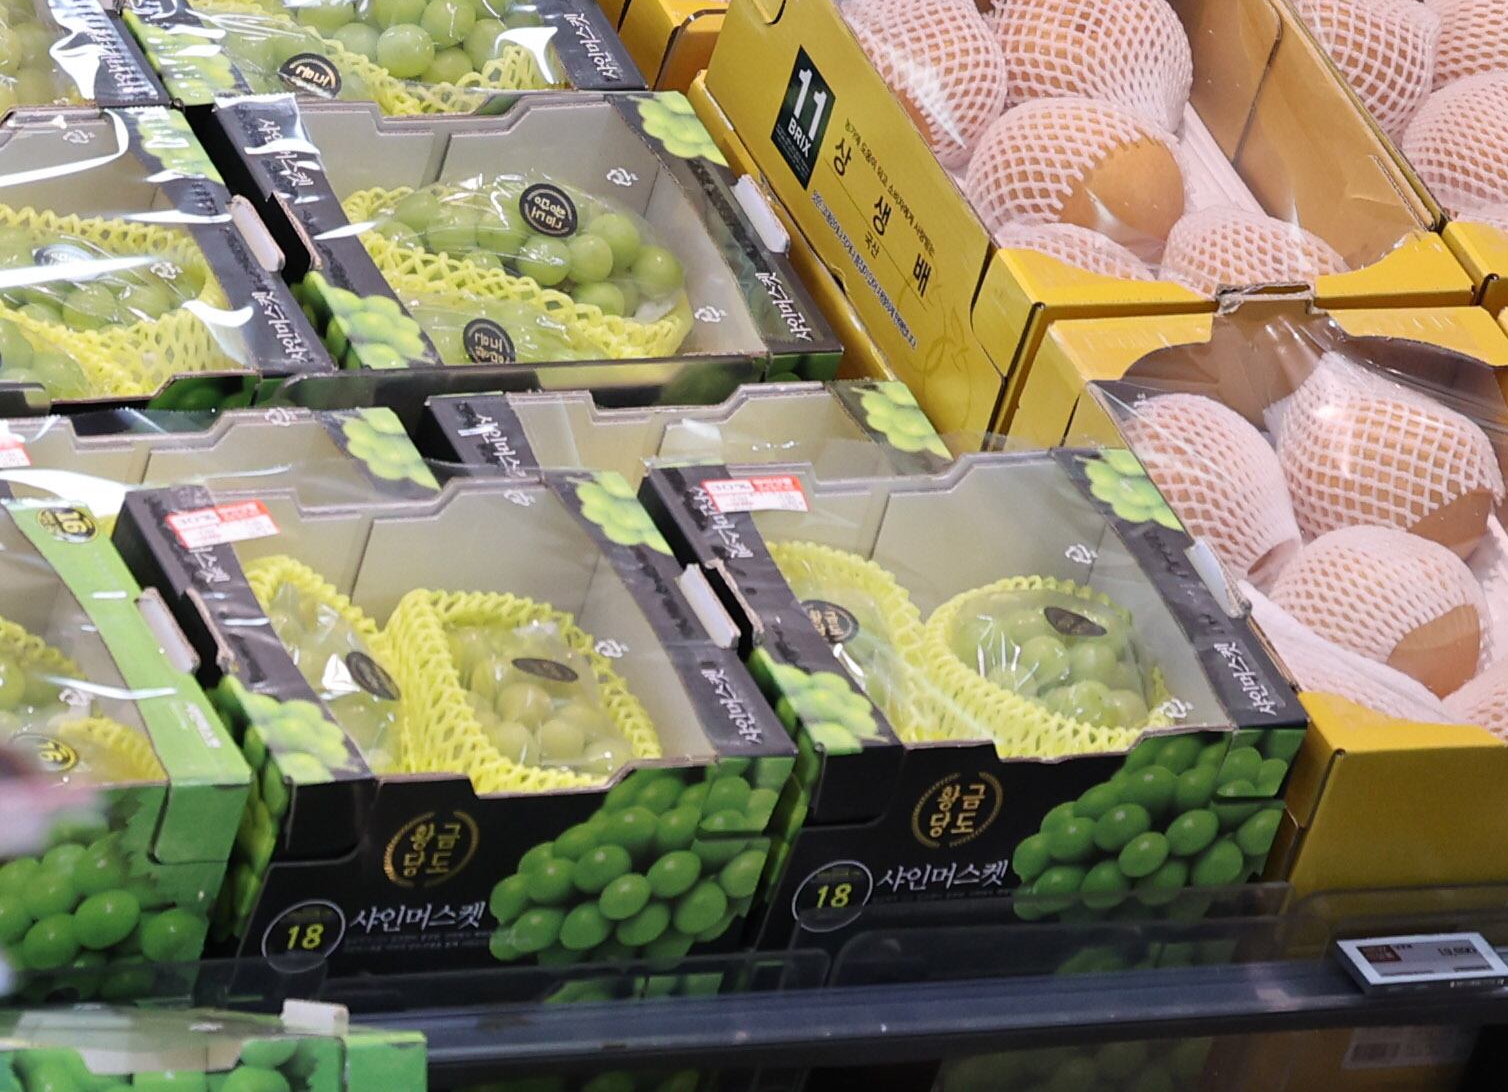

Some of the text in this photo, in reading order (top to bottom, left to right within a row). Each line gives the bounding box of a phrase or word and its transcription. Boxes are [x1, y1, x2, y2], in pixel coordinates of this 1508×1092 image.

[563, 11, 622, 81] 샤인머스켓
[794, 69, 828, 142] 11
[787, 117, 813, 158] BRIX
[864, 228, 881, 259] 국산
[755, 271, 813, 342] 샤인머스켓
[250, 290, 312, 363] 샤인머스켓
[1212, 640, 1278, 717] 샤인머스켓
[701, 667, 763, 744] 샤인머스켓
[937, 782, 987, 811] 황금
[410, 822, 461, 851] 황금
[929, 808, 976, 838] 당도
[403, 848, 451, 878] 당도
[876, 859, 1009, 893] 샤인머스켓
[816, 883, 851, 909] 18
[350, 900, 486, 934] 샤인머스켓
[287, 923, 323, 951] 18
